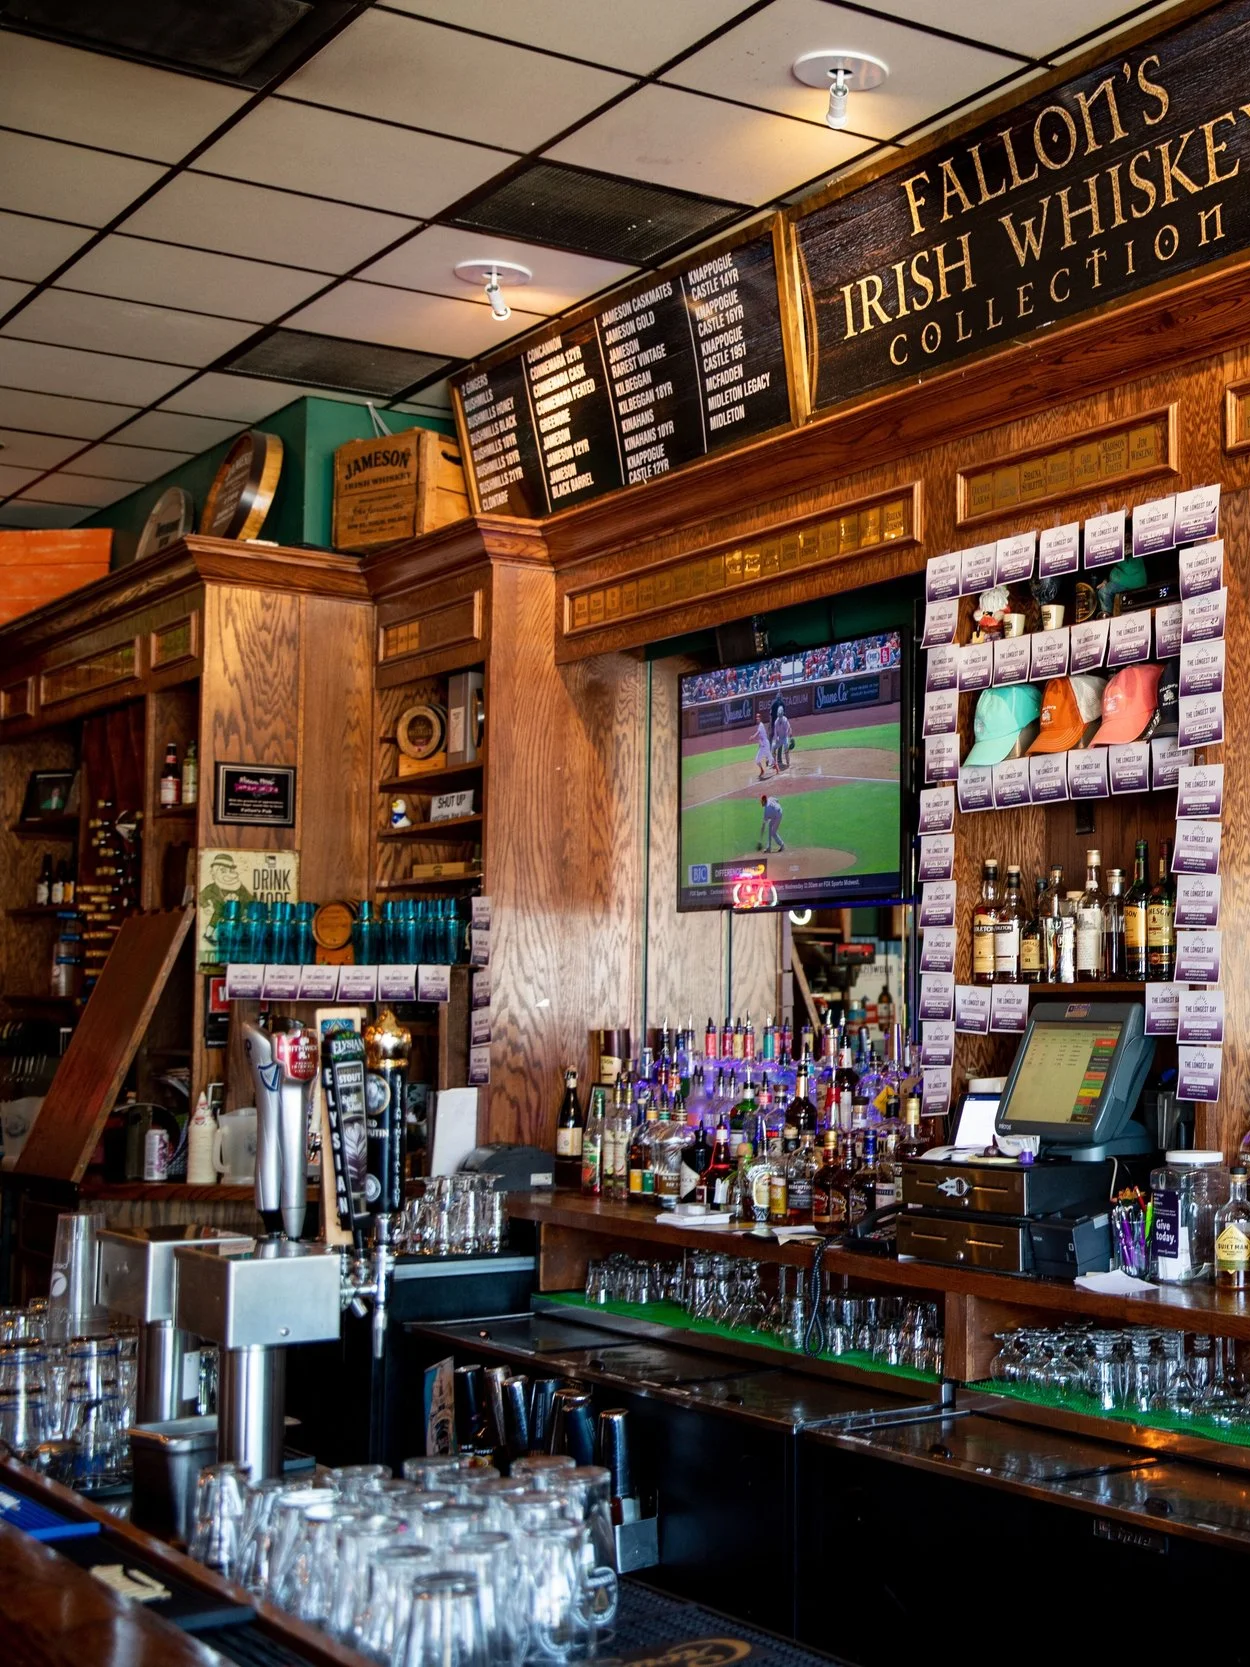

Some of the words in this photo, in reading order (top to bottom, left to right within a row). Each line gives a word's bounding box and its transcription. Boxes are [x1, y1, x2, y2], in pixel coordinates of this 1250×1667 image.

[687, 252, 733, 286] KNAPPOGUE
[889, 202, 1226, 366] COLLECTION
[691, 275, 719, 301] CASTLE
[720, 268, 739, 290] 14YR
[839, 232, 976, 340] IRISH
[602, 299, 632, 327] JAMESON
[632, 281, 672, 312] CASKMATES
[609, 338, 640, 364] JAMESON
[611, 357, 638, 379] RAREST
[638, 343, 666, 367] VINTAGE
[703, 349, 730, 373] CASTLE
[730, 342, 747, 363] 1951
[615, 370, 652, 397] KILBEGGAN
[705, 364, 743, 392] MCFADDEN
[708, 385, 743, 412] MIDLETON
[744, 372, 770, 397] LEGACY
[709, 404, 745, 431] MIDLETON
[345, 450, 409, 480] JAMESON
[438, 795, 455, 809] SHUT
[456, 794, 466, 806] UP
[253, 869, 291, 891] DRINK
[339, 1072, 361, 1084] STOUT
